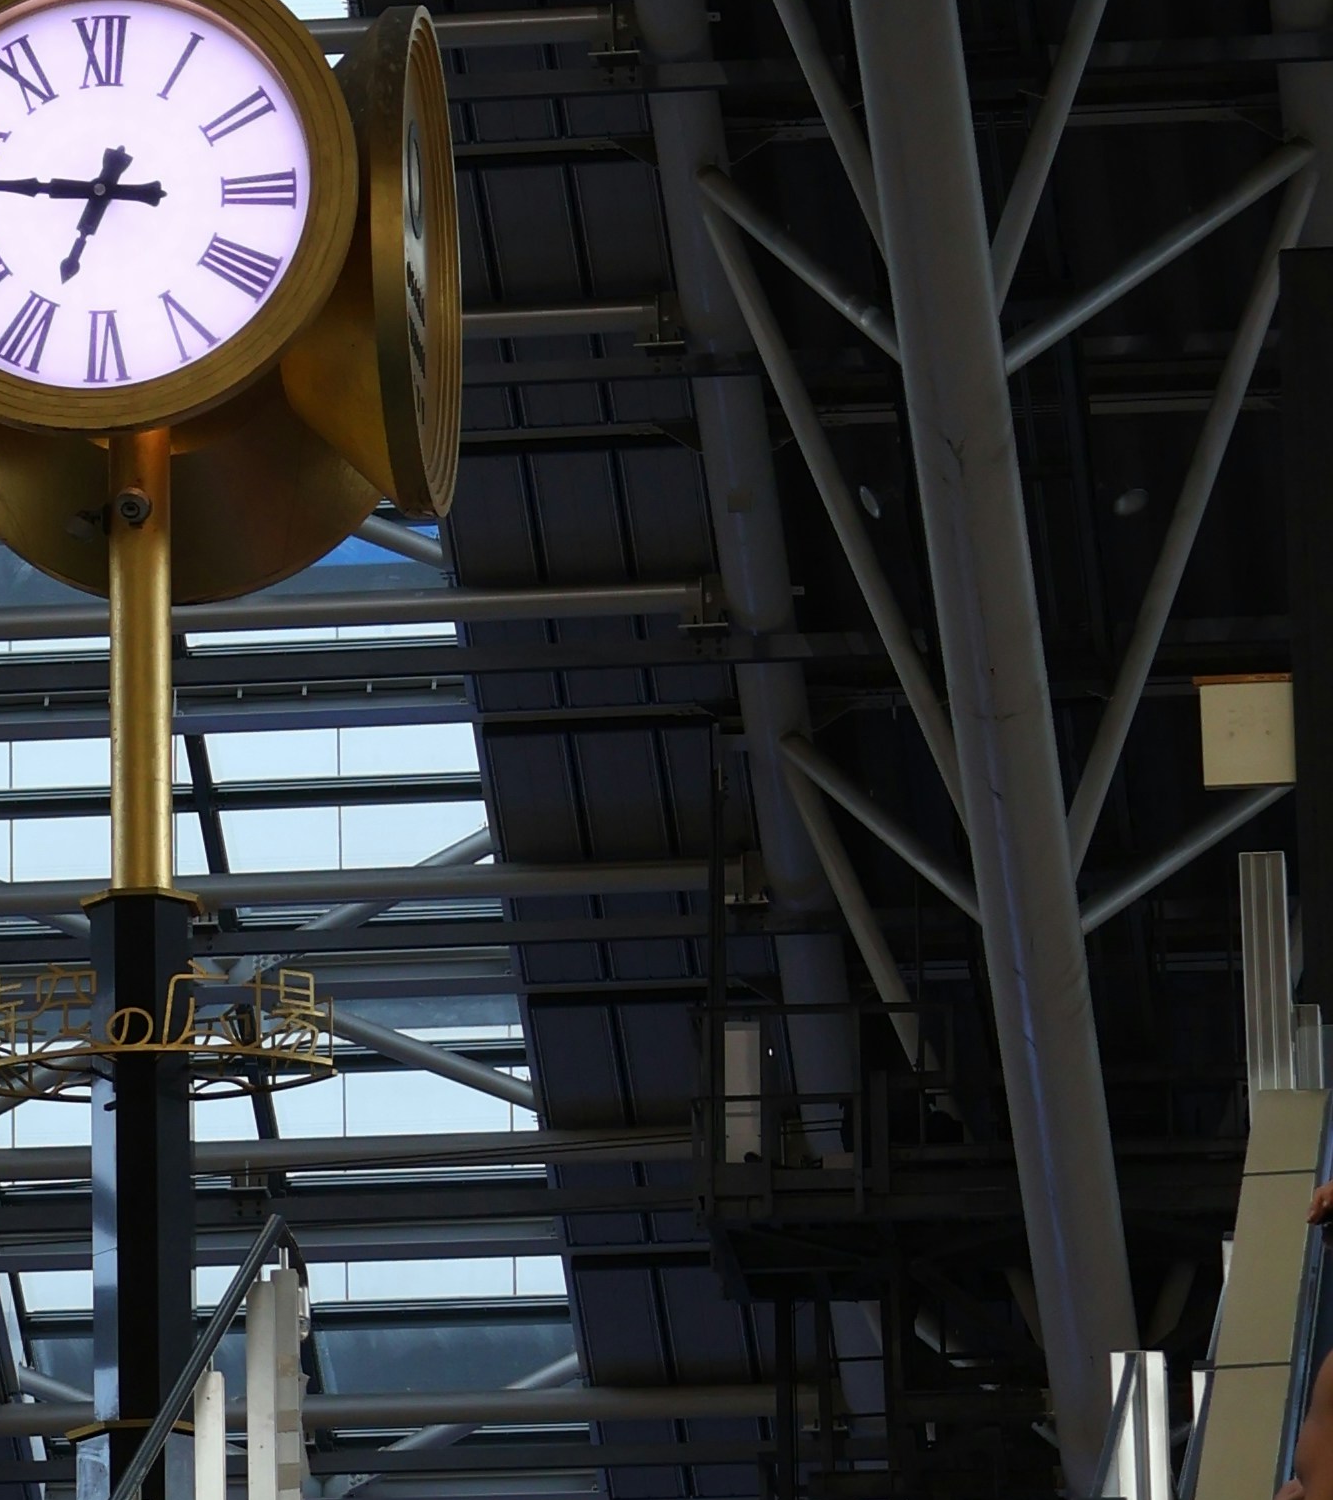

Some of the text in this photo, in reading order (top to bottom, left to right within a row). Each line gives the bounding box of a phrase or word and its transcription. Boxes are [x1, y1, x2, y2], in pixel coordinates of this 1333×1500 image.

[72, 14, 131, 89] XII
[157, 31, 205, 100] I
[199, 85, 277, 147] II
[220, 167, 298, 210] III
[197, 232, 283, 303] IIII
[83, 310, 131, 384] VI
[157, 289, 221, 364] V
